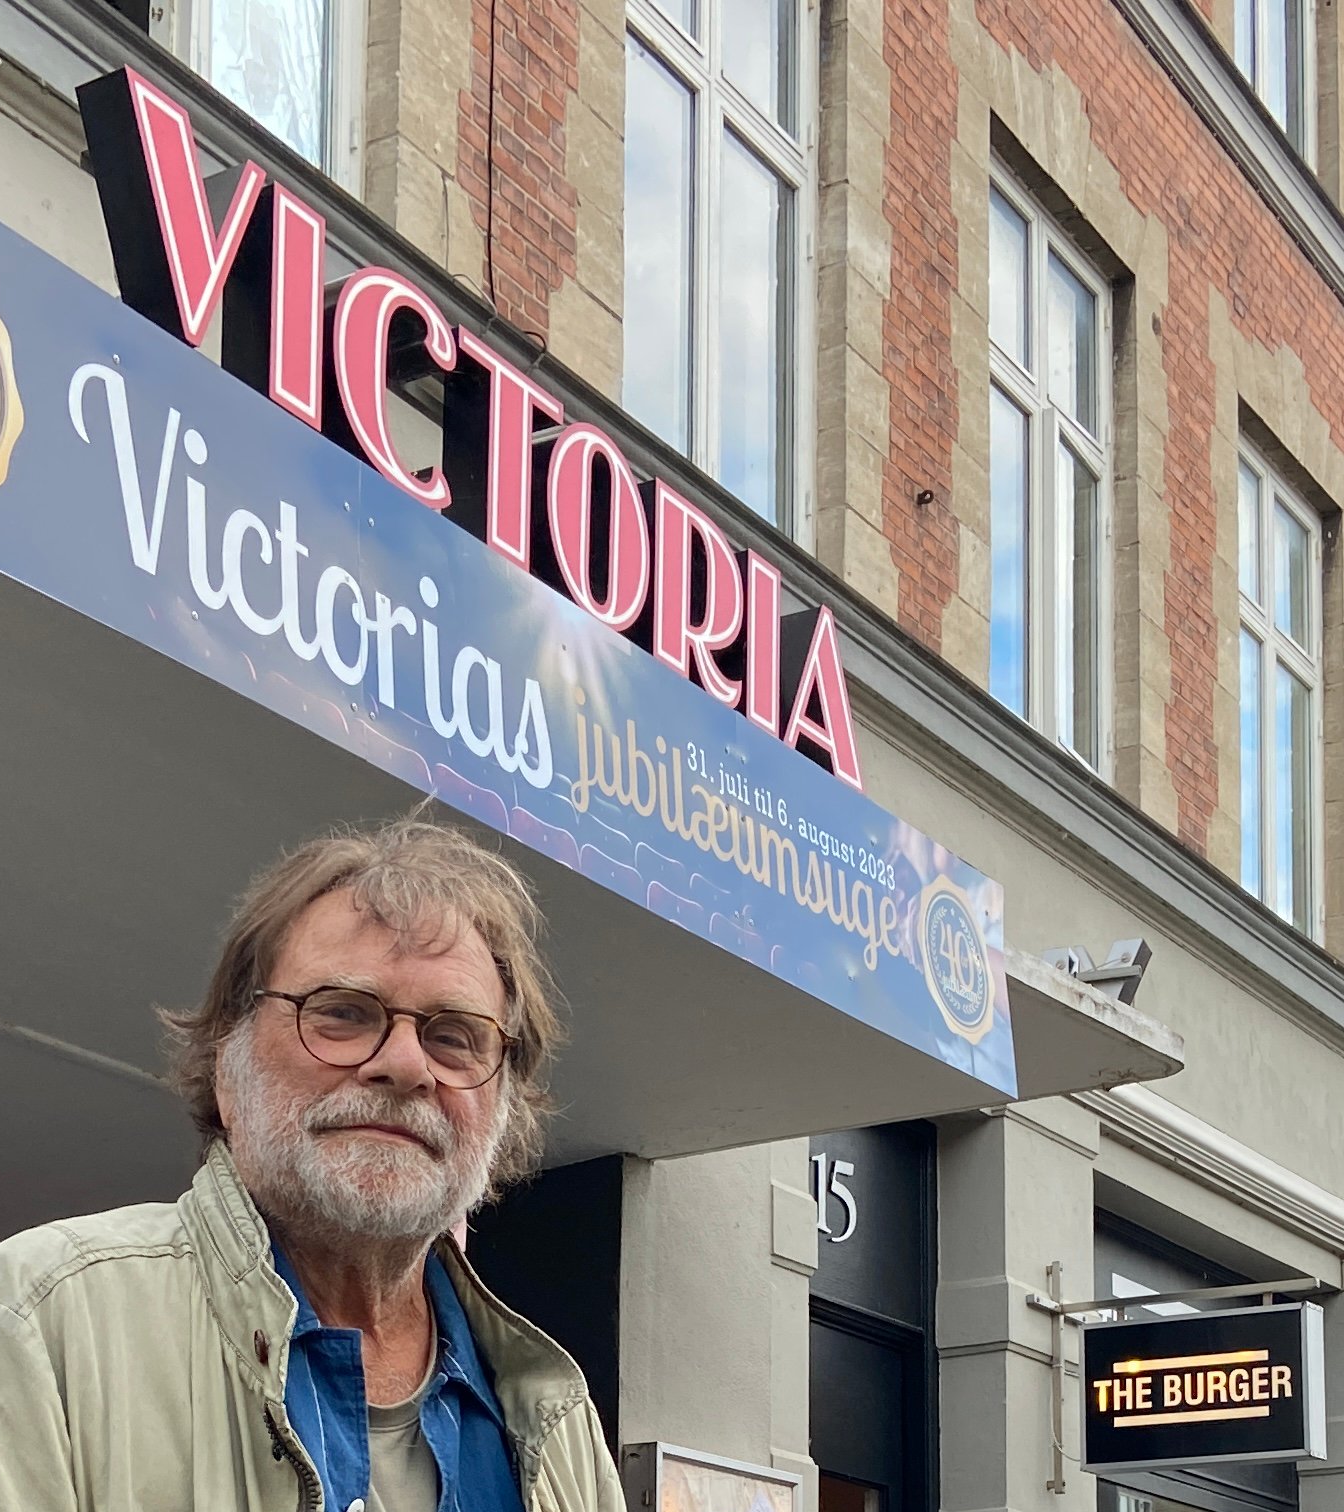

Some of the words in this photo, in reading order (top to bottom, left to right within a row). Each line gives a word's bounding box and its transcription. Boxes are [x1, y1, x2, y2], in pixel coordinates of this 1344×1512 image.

[126, 64, 866, 793] VICTORIA
[68, 362, 554, 789] Victorias
[571, 686, 901, 971] jubilæumsuge
[687, 741, 715, 784] 31.
[717, 762, 750, 805] juli
[754, 787, 774, 821] til
[777, 799, 794, 831] 6.
[797, 817, 856, 868] august
[858, 847, 897, 890] 2023
[940, 919, 974, 992] 40
[811, 1152, 858, 1243] 15
[1093, 1376, 1153, 1412] THE
[1163, 1365, 1293, 1408] BURGER
